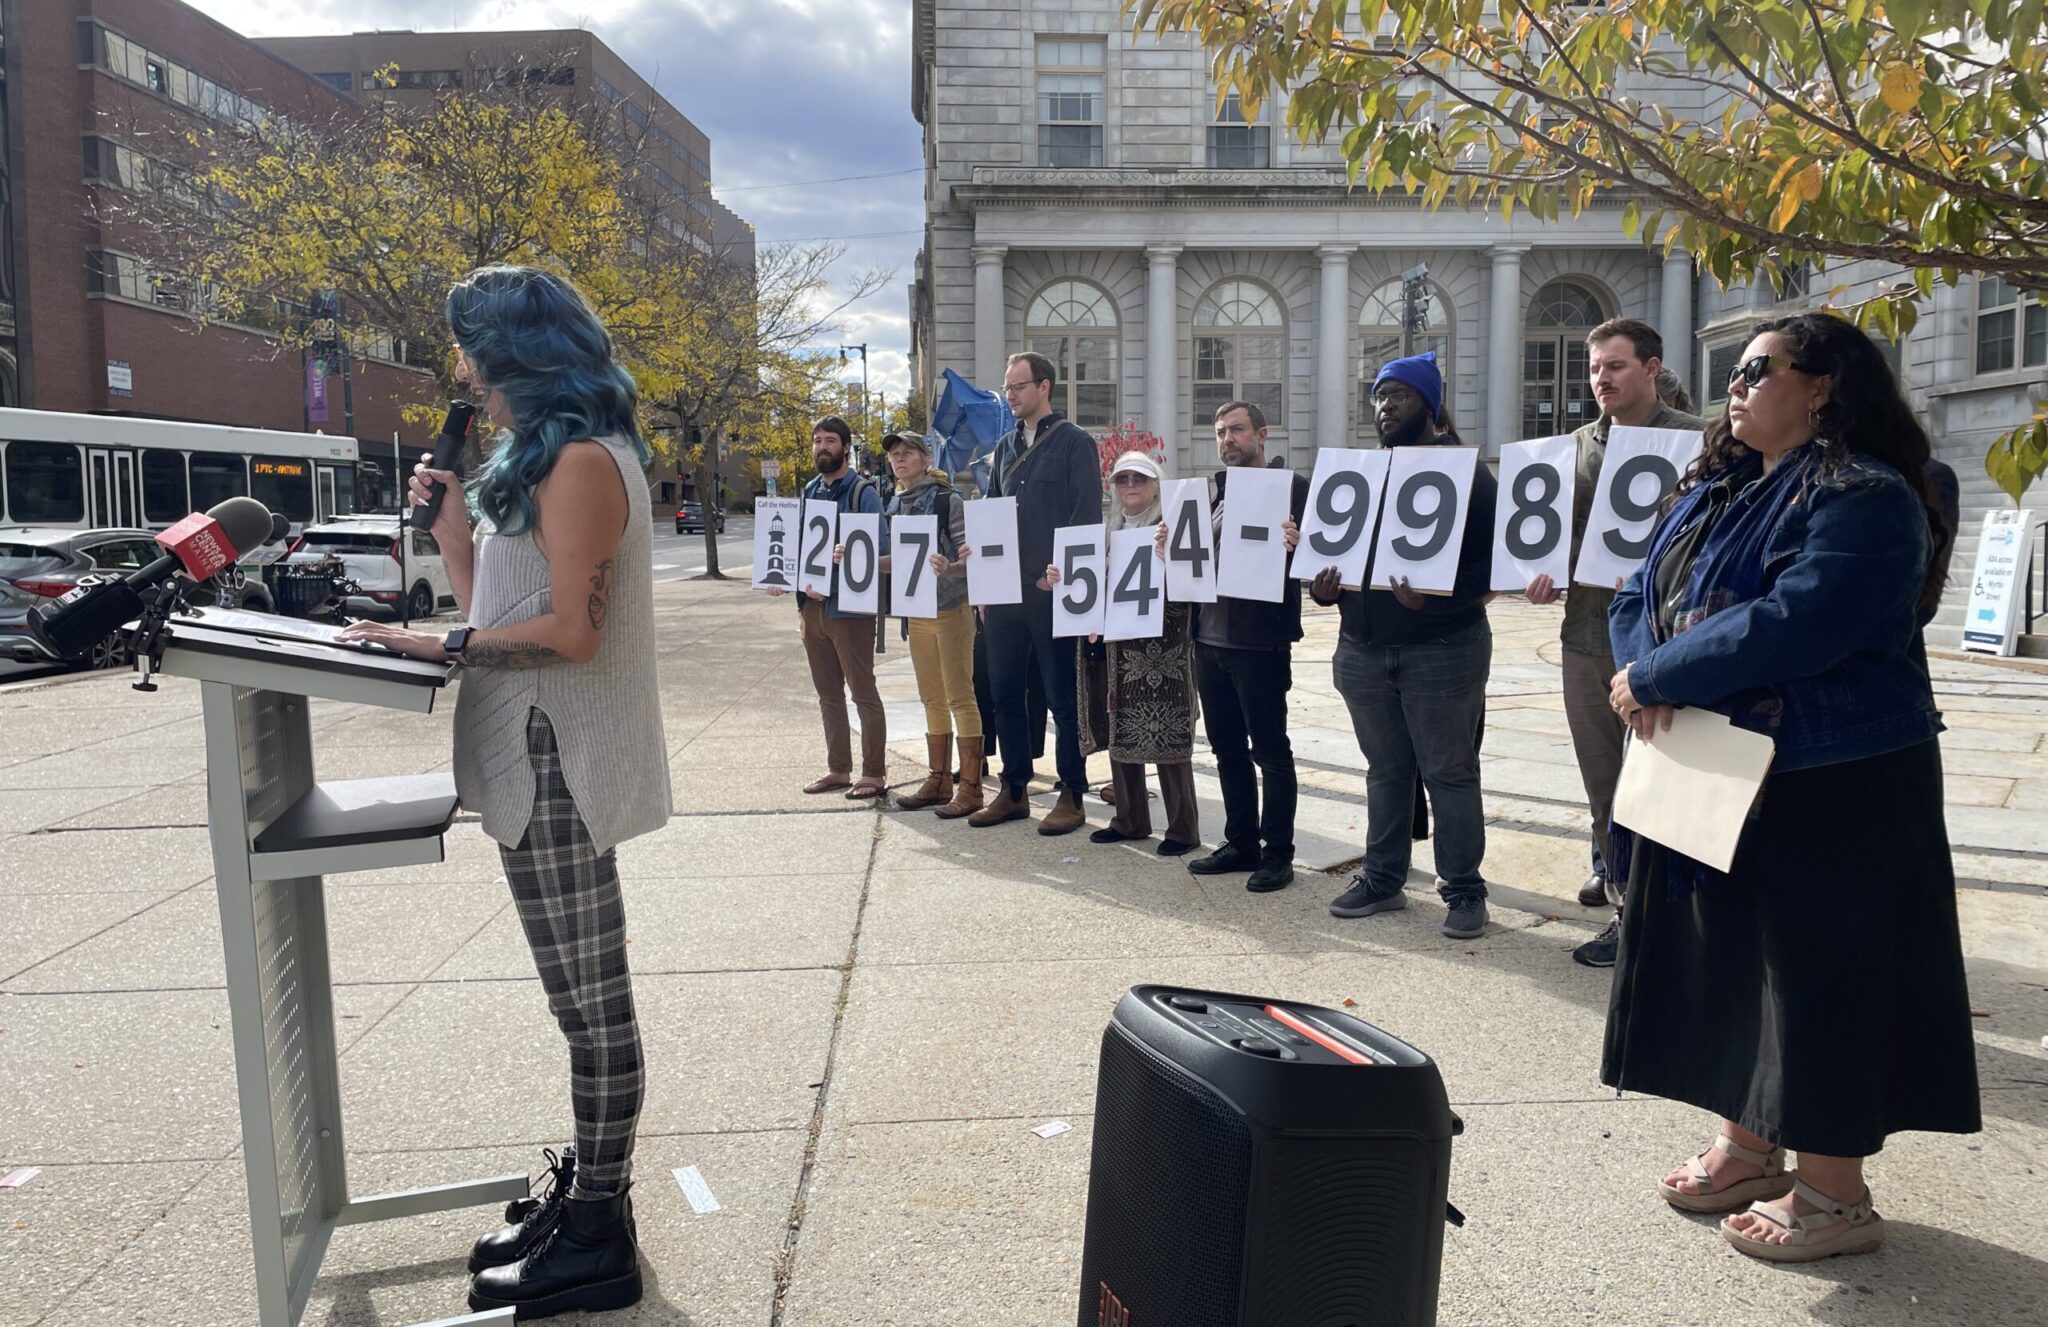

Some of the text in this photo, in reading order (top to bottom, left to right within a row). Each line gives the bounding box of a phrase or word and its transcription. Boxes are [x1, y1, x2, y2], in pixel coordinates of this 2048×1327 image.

[255, 463, 260, 473] 1
[260, 464, 273, 474] PTC
[769, 501, 778, 509] the
[1309, 471, 1370, 556] 9
[1392, 471, 1457, 561] 9
[1505, 463, 1562, 560] 8
[1602, 455, 1679, 559] 9
[190, 540, 213, 572] MAINE
[195, 534, 222, 568] CENTER
[201, 529, 222, 554] NEWS
[785, 563, 796, 571] ICE
[804, 515, 829, 577] 2
[842, 529, 874, 593] 0
[900, 533, 930, 597] 7
[1170, 500, 1209, 578] 4
[1062, 543, 1097, 615] 5
[1113, 545, 1159, 615] 4
